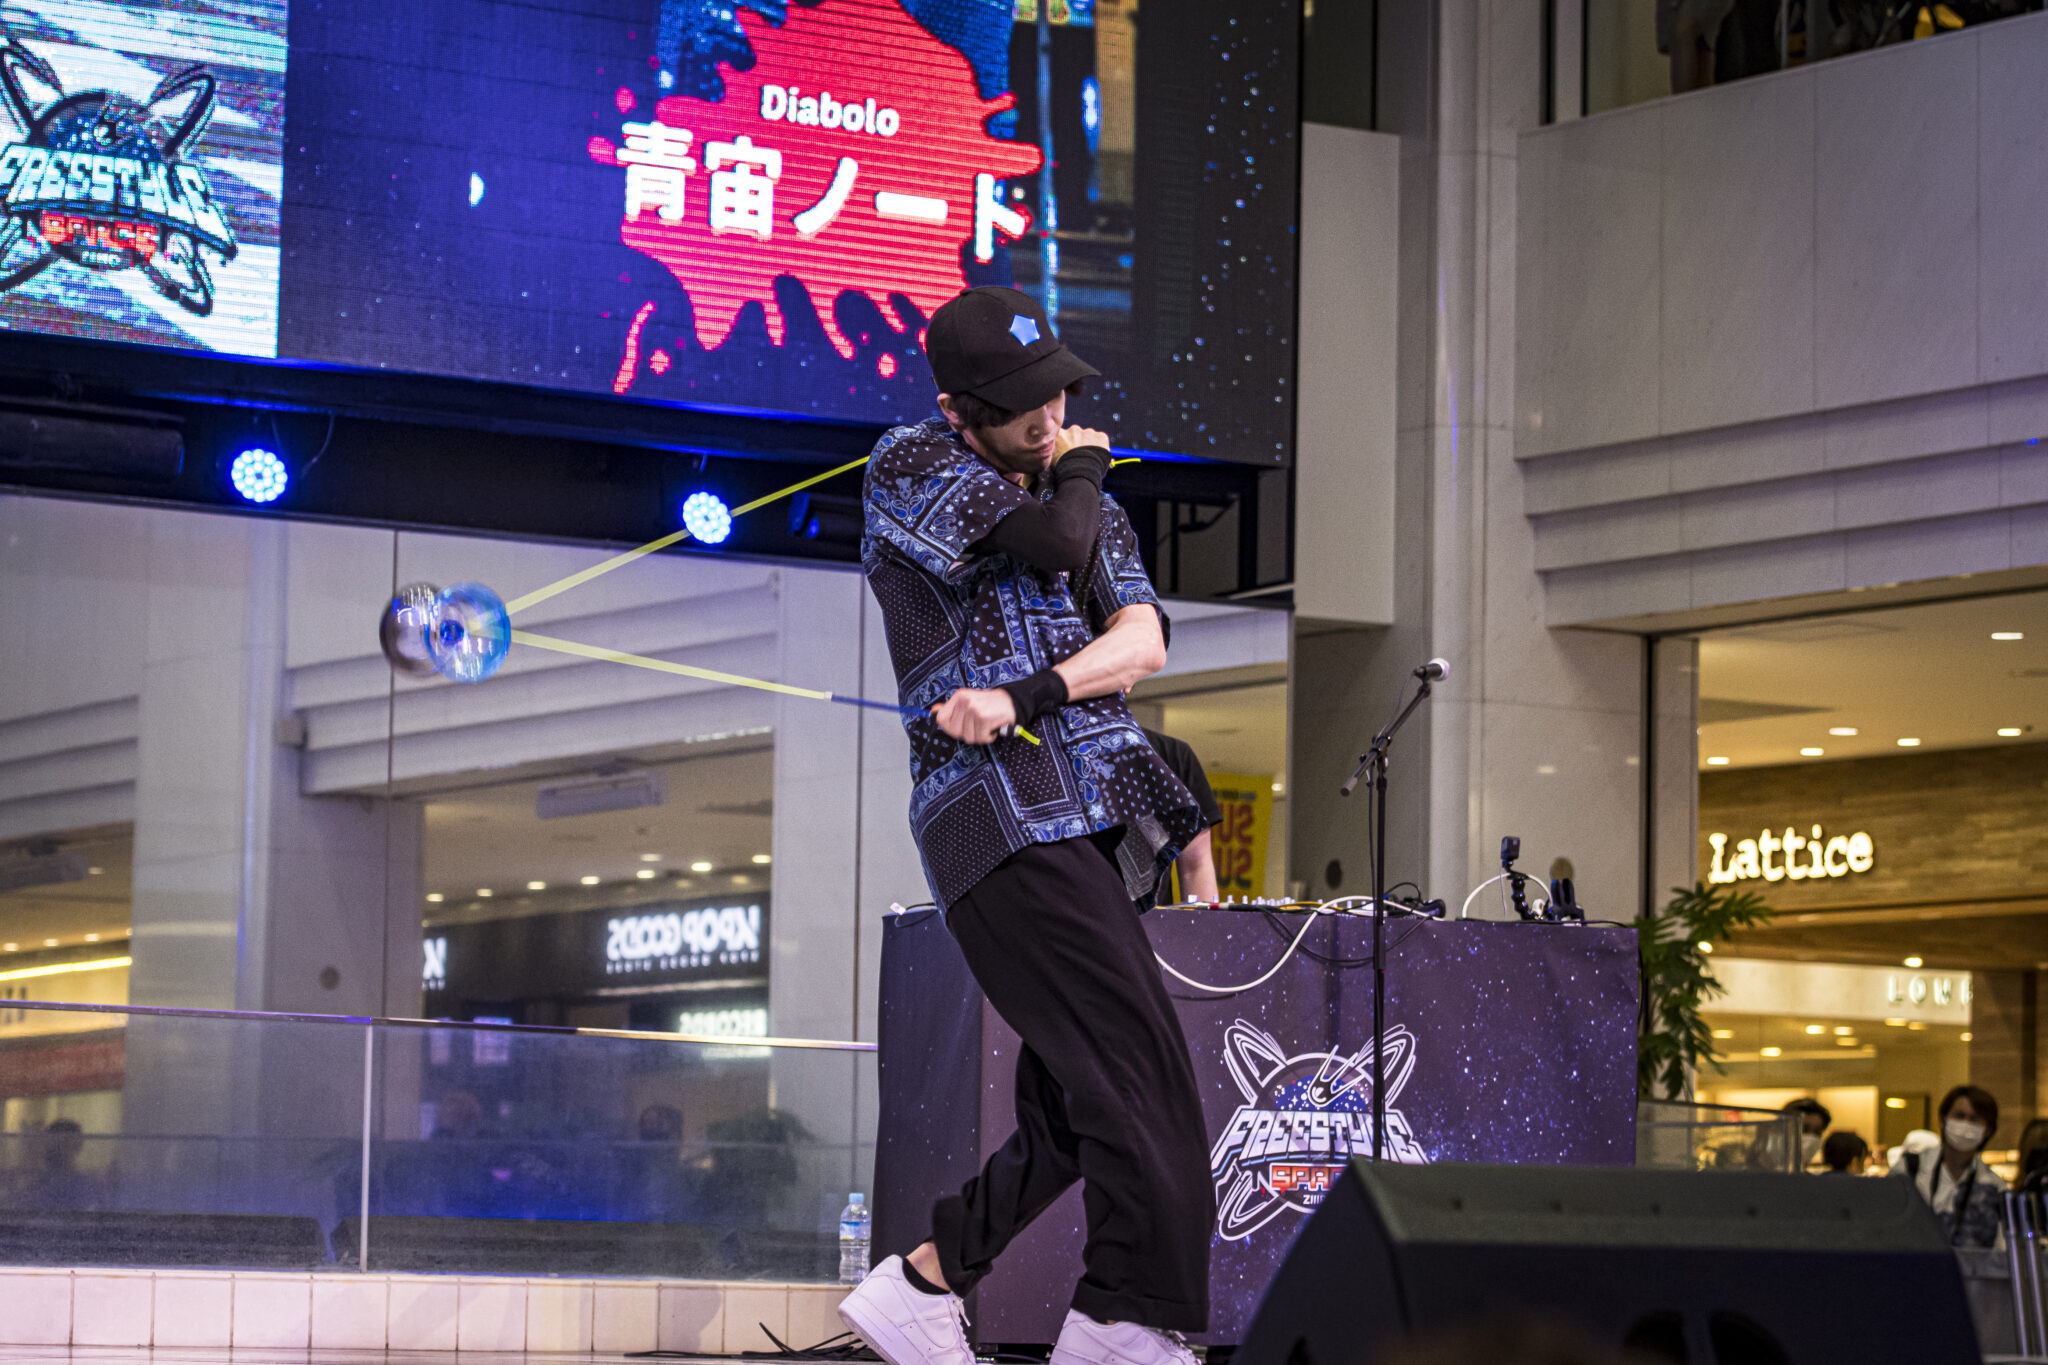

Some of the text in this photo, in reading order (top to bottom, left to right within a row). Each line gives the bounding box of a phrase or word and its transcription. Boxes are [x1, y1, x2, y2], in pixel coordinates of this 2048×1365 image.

[761, 85, 900, 136] Diabolo
[616, 121, 1026, 261] 青宙ノート
[1708, 824, 1874, 884] Lattice
[1271, 1166, 1344, 1193] SPA
